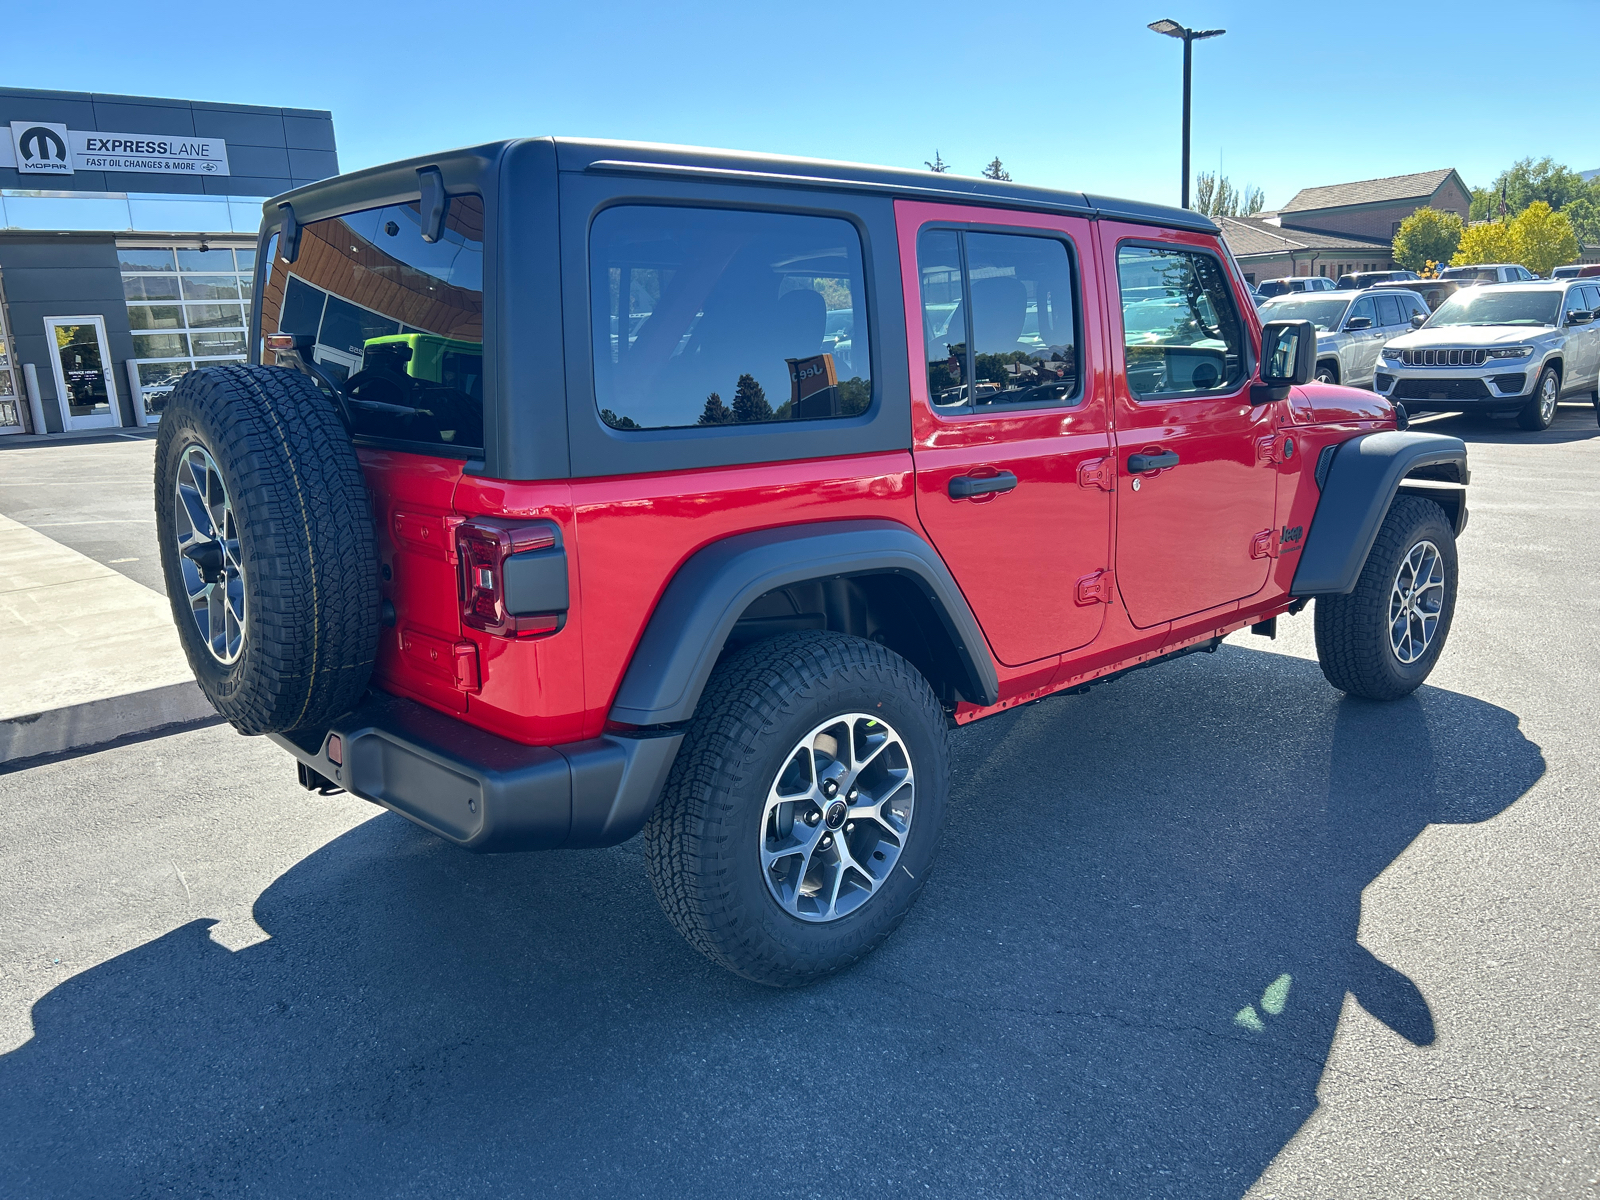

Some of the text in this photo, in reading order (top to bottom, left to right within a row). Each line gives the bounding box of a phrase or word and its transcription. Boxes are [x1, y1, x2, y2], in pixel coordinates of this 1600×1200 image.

[86, 158, 107, 167] FAST
[109, 159, 122, 168] OIL
[124, 160, 163, 169] CHANGES
[164, 161, 171, 170] &
[172, 162, 196, 171] MORE
[1279, 525, 1303, 544] Jeep
